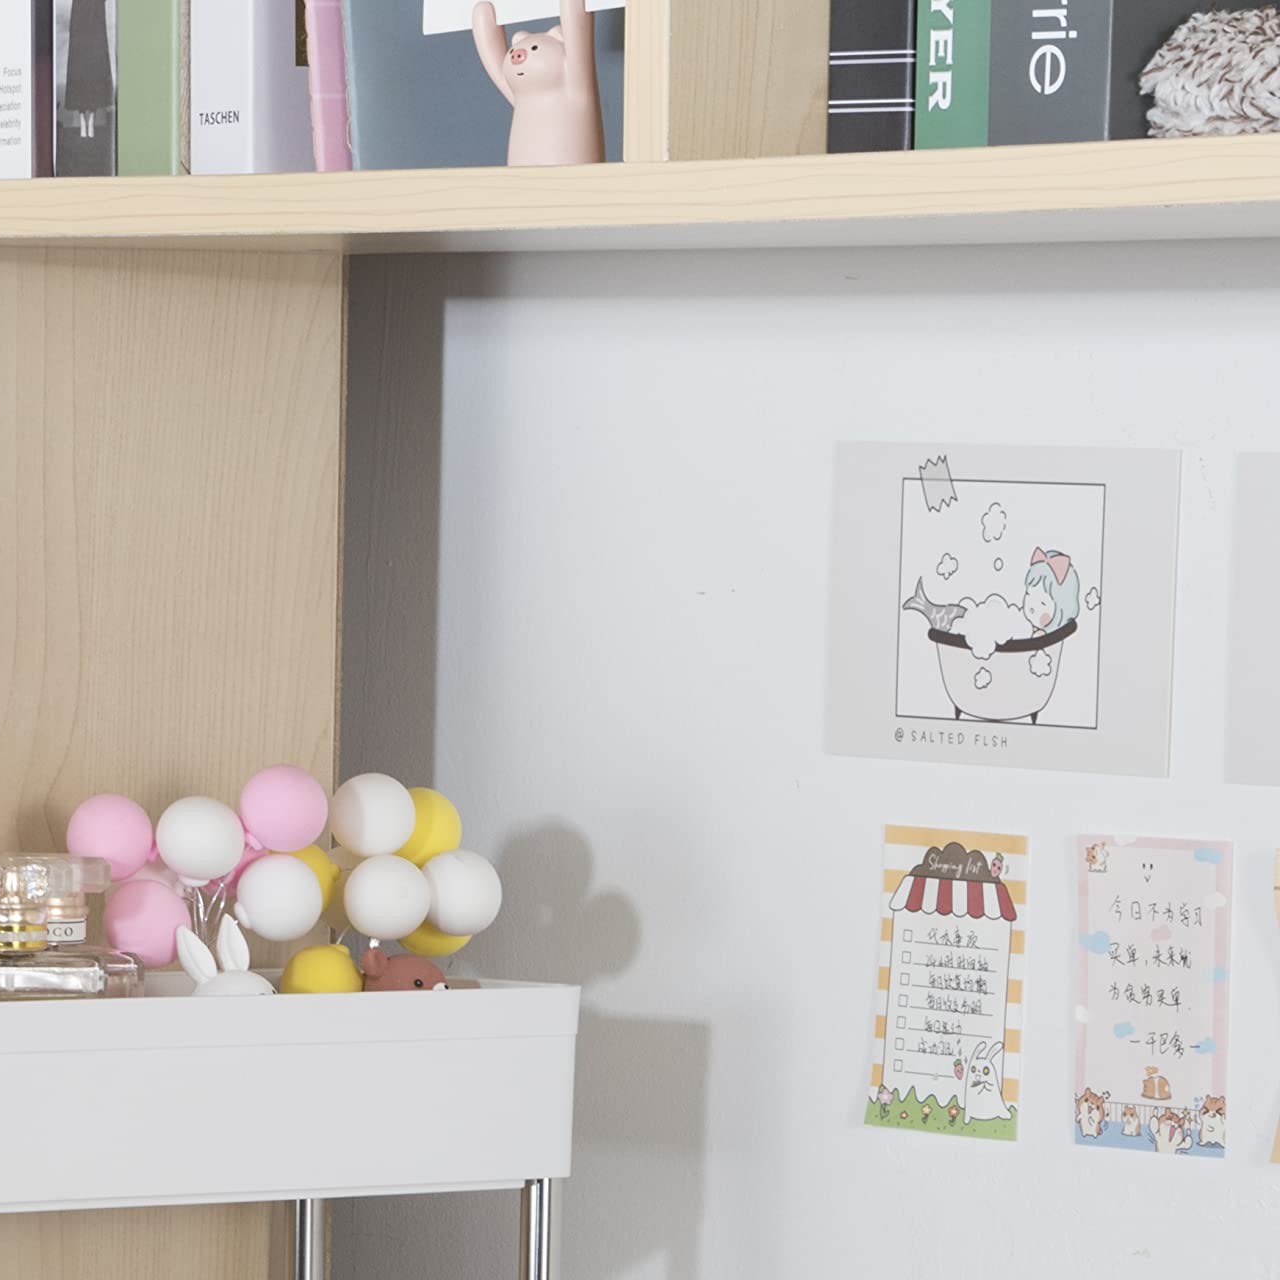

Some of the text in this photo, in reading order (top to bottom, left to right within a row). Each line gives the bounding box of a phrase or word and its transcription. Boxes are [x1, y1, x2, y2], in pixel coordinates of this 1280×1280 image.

[1029, 0, 1078, 95] rie
[3, 67, 22, 77] Focus
[0, 84, 22, 95] Hotspot
[199, 110, 240, 126] TASCHEN
[910, 730, 966, 745] SALTED
[928, 853, 983, 878] Shopping list
[47, 926, 74, 938] CO
